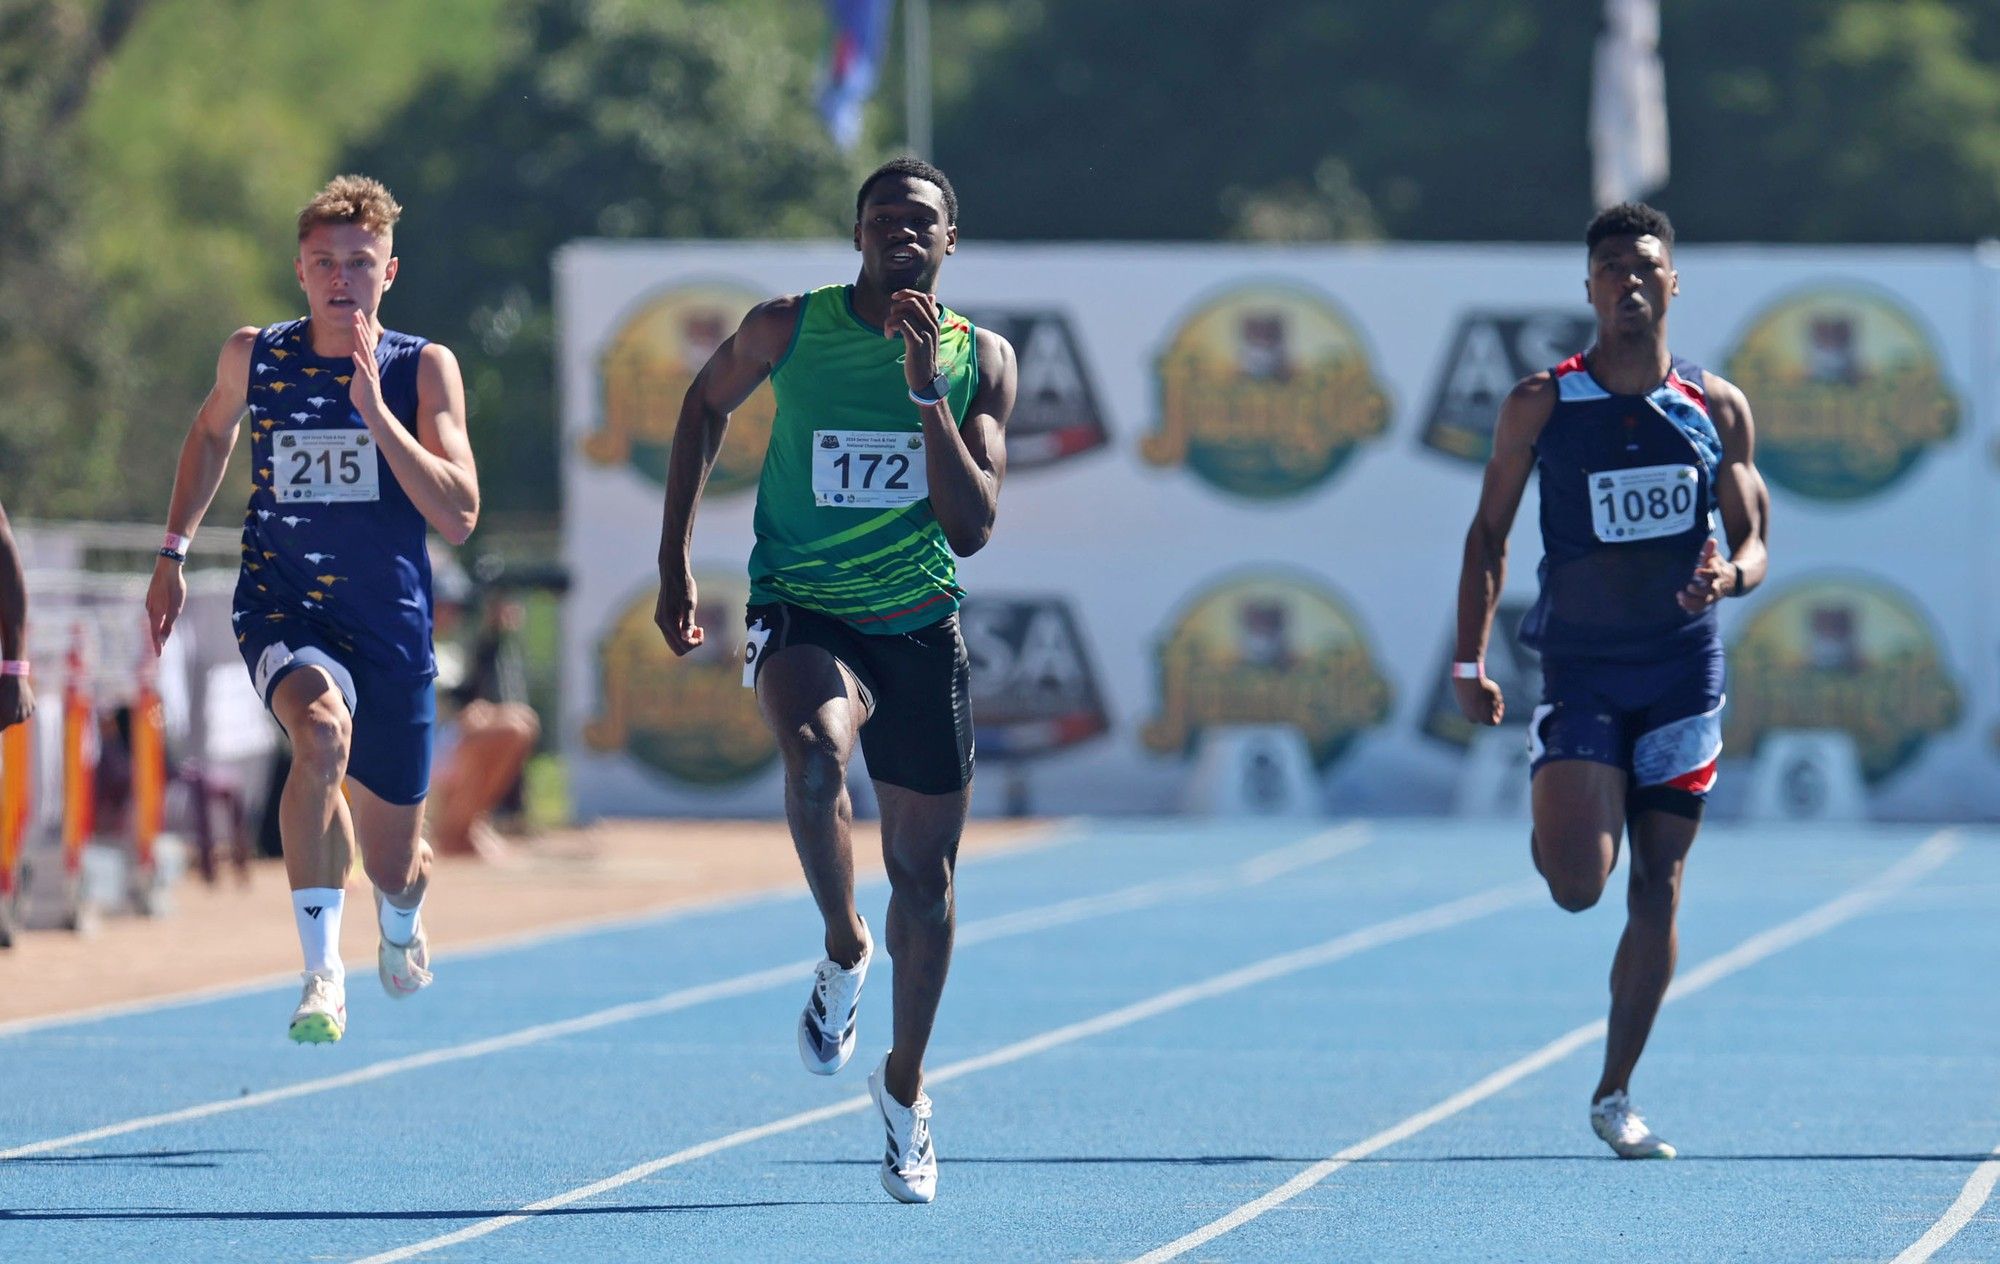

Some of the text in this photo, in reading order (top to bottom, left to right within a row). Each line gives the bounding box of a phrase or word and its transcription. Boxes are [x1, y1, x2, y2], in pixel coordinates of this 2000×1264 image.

[290, 450, 361, 485] 215
[833, 453, 910, 489] 172
[1599, 484, 1691, 523] 1080
